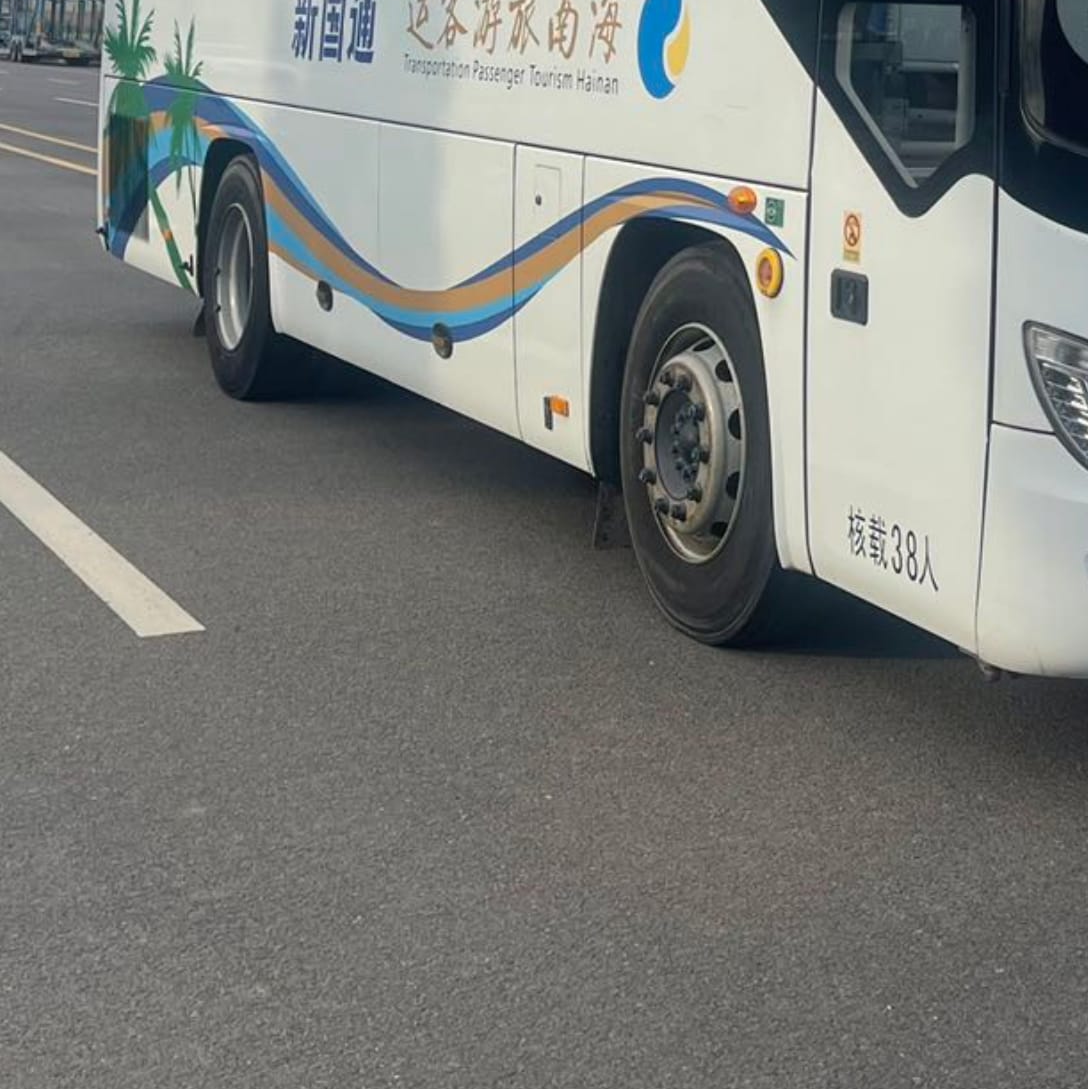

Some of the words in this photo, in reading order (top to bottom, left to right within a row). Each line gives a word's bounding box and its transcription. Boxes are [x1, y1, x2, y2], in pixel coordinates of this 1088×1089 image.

[404, 53, 470, 81] Transportation
[473, 60, 525, 89] Passenger
[530, 64, 573, 90] Tourism
[576, 68, 619, 95] Hainan
[847, 504, 939, 592] 核载38人
